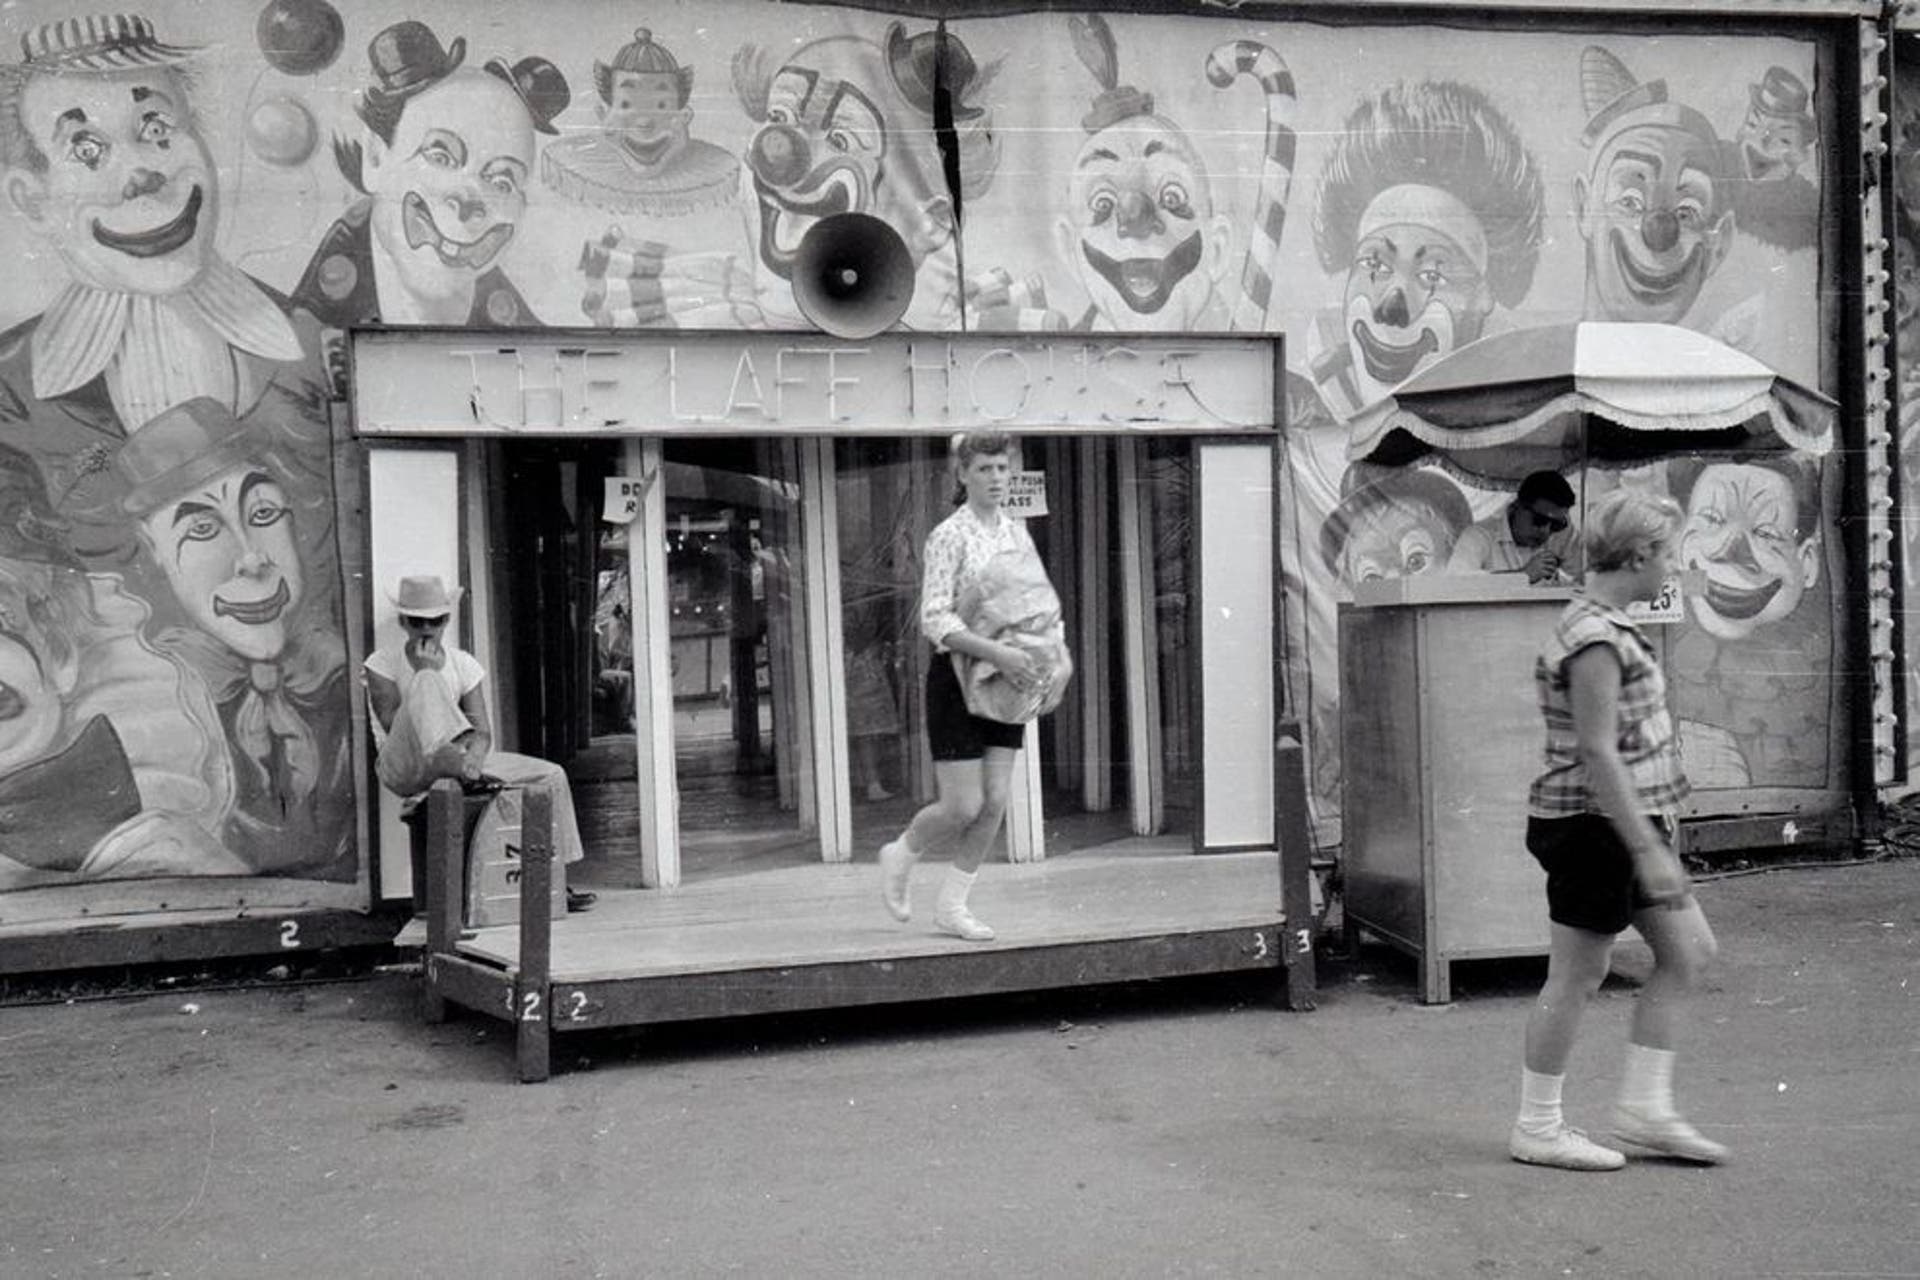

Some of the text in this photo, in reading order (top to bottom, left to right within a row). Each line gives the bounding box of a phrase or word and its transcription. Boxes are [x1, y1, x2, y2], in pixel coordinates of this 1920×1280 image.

[448, 347, 622, 427] THE
[668, 345, 871, 422] LAFF
[280, 920, 300, 947] 2
[1253, 932, 1267, 960] 3
[1295, 929, 1311, 953] 3
[522, 992, 542, 1021] 2
[571, 990, 588, 1021] 2
